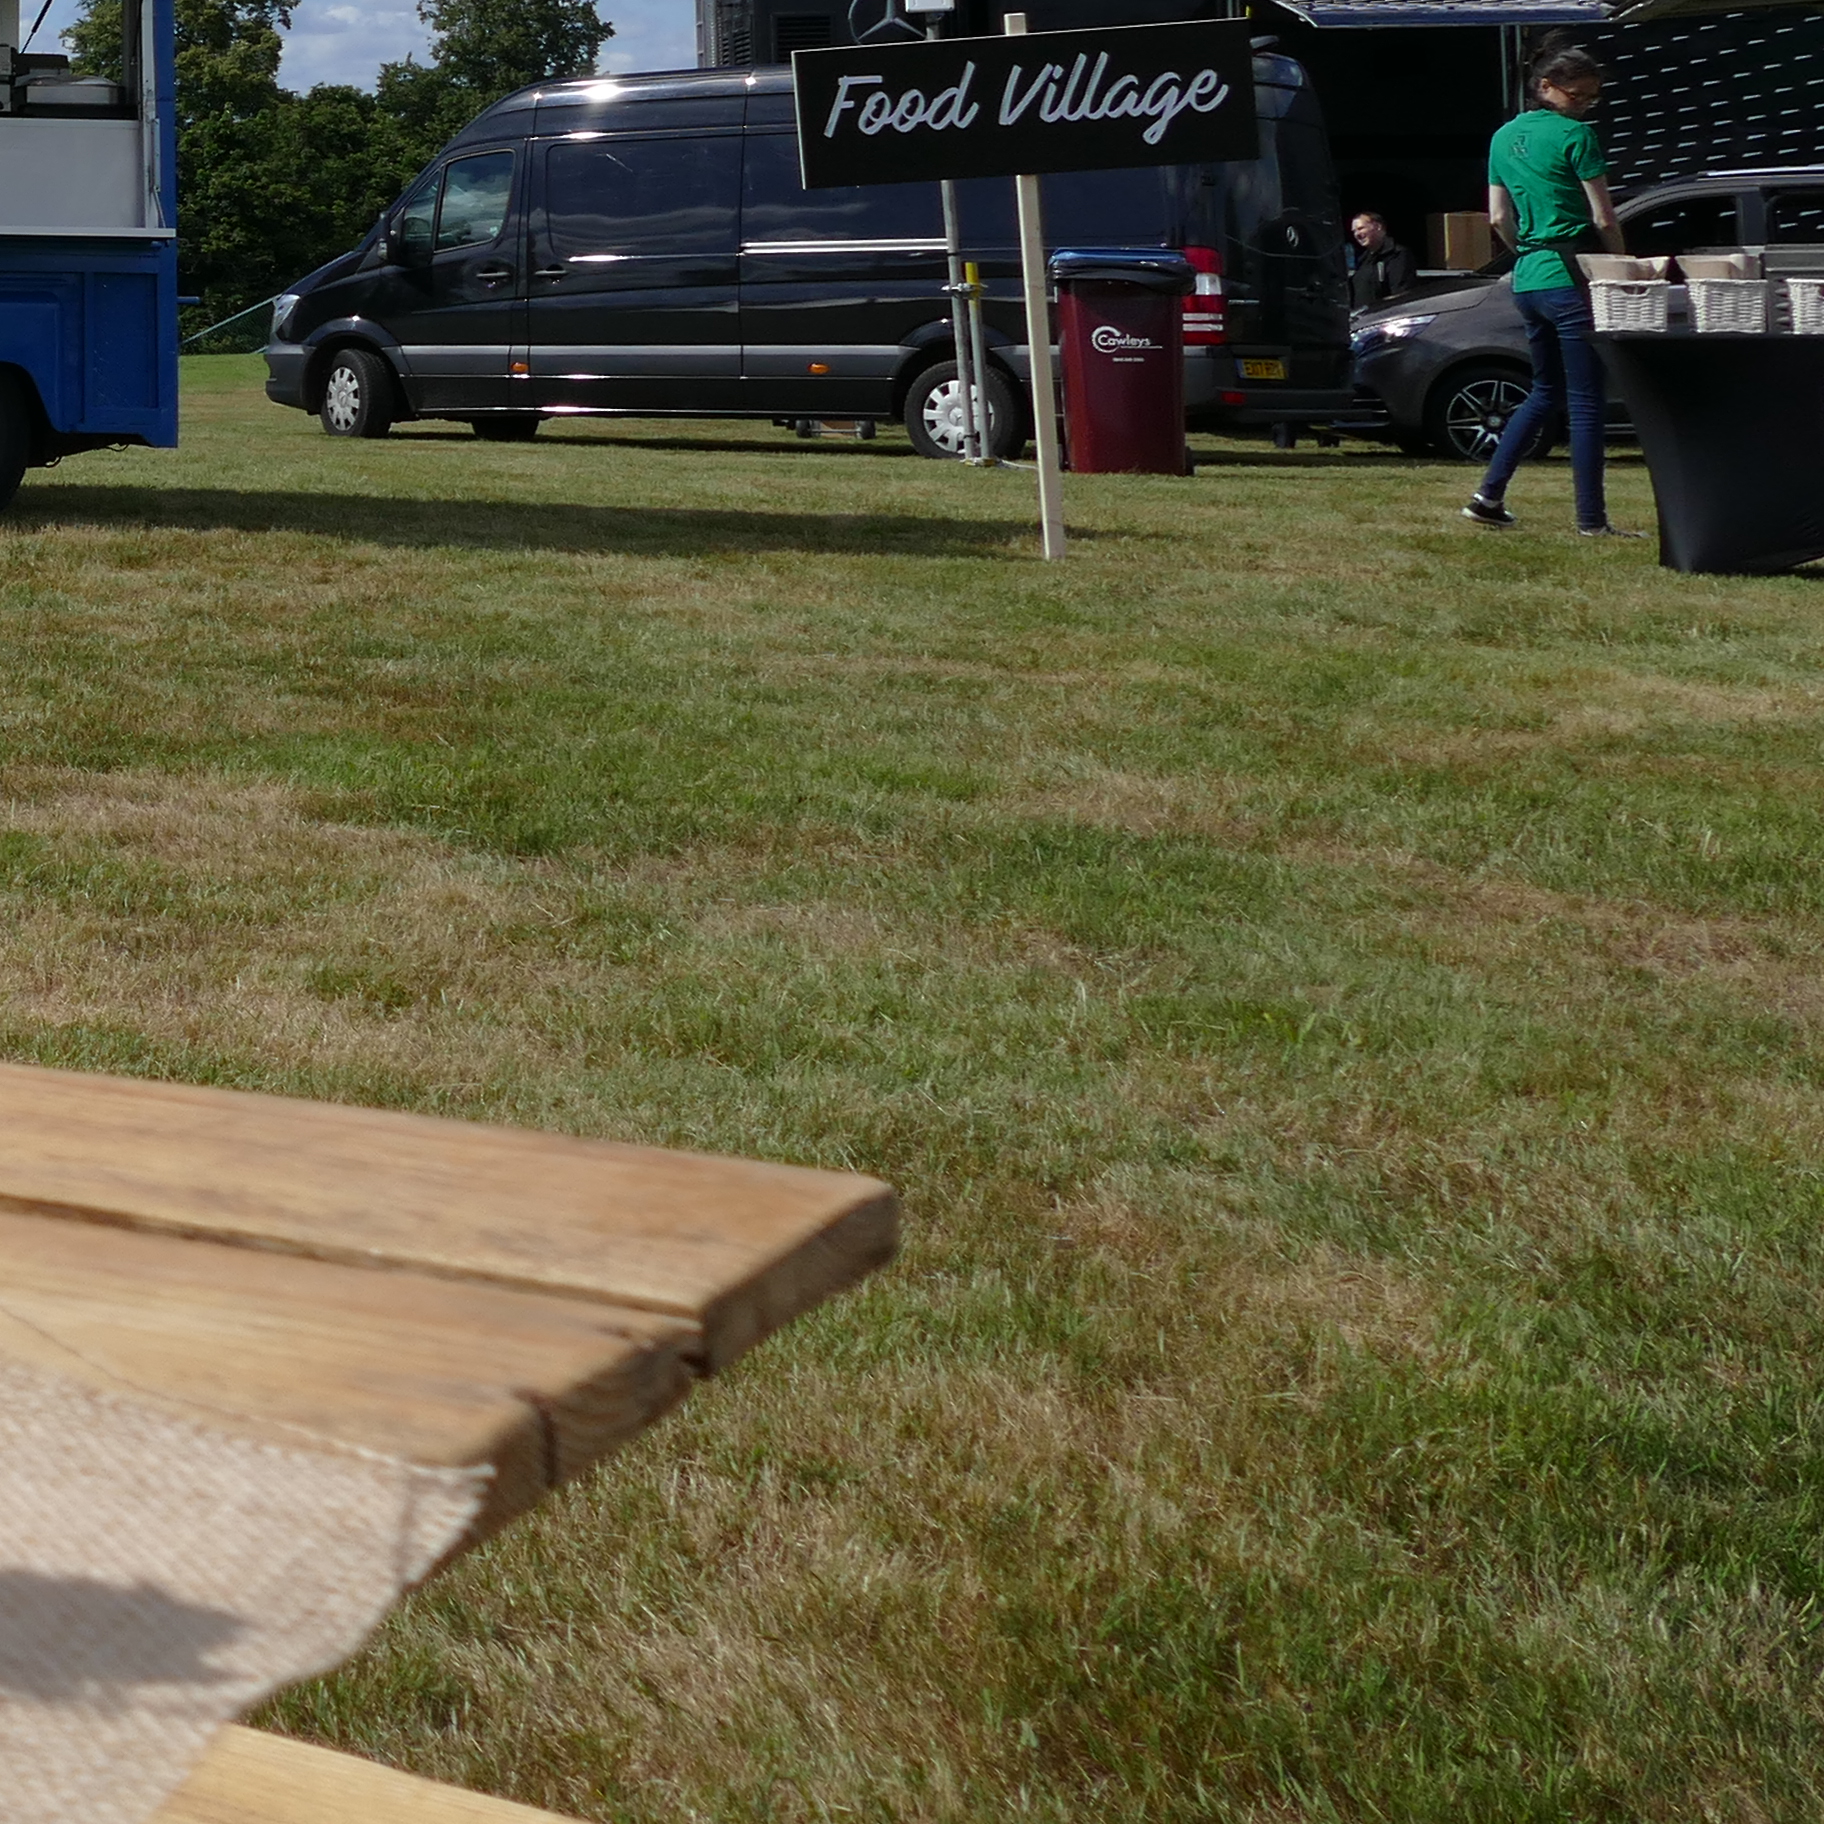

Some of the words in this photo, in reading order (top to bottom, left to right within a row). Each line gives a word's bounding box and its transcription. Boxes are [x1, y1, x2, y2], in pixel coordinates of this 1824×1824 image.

[824, 61, 979, 138] Food
[999, 51, 1229, 145] Village
[1097, 333, 1152, 349] Cawleys
